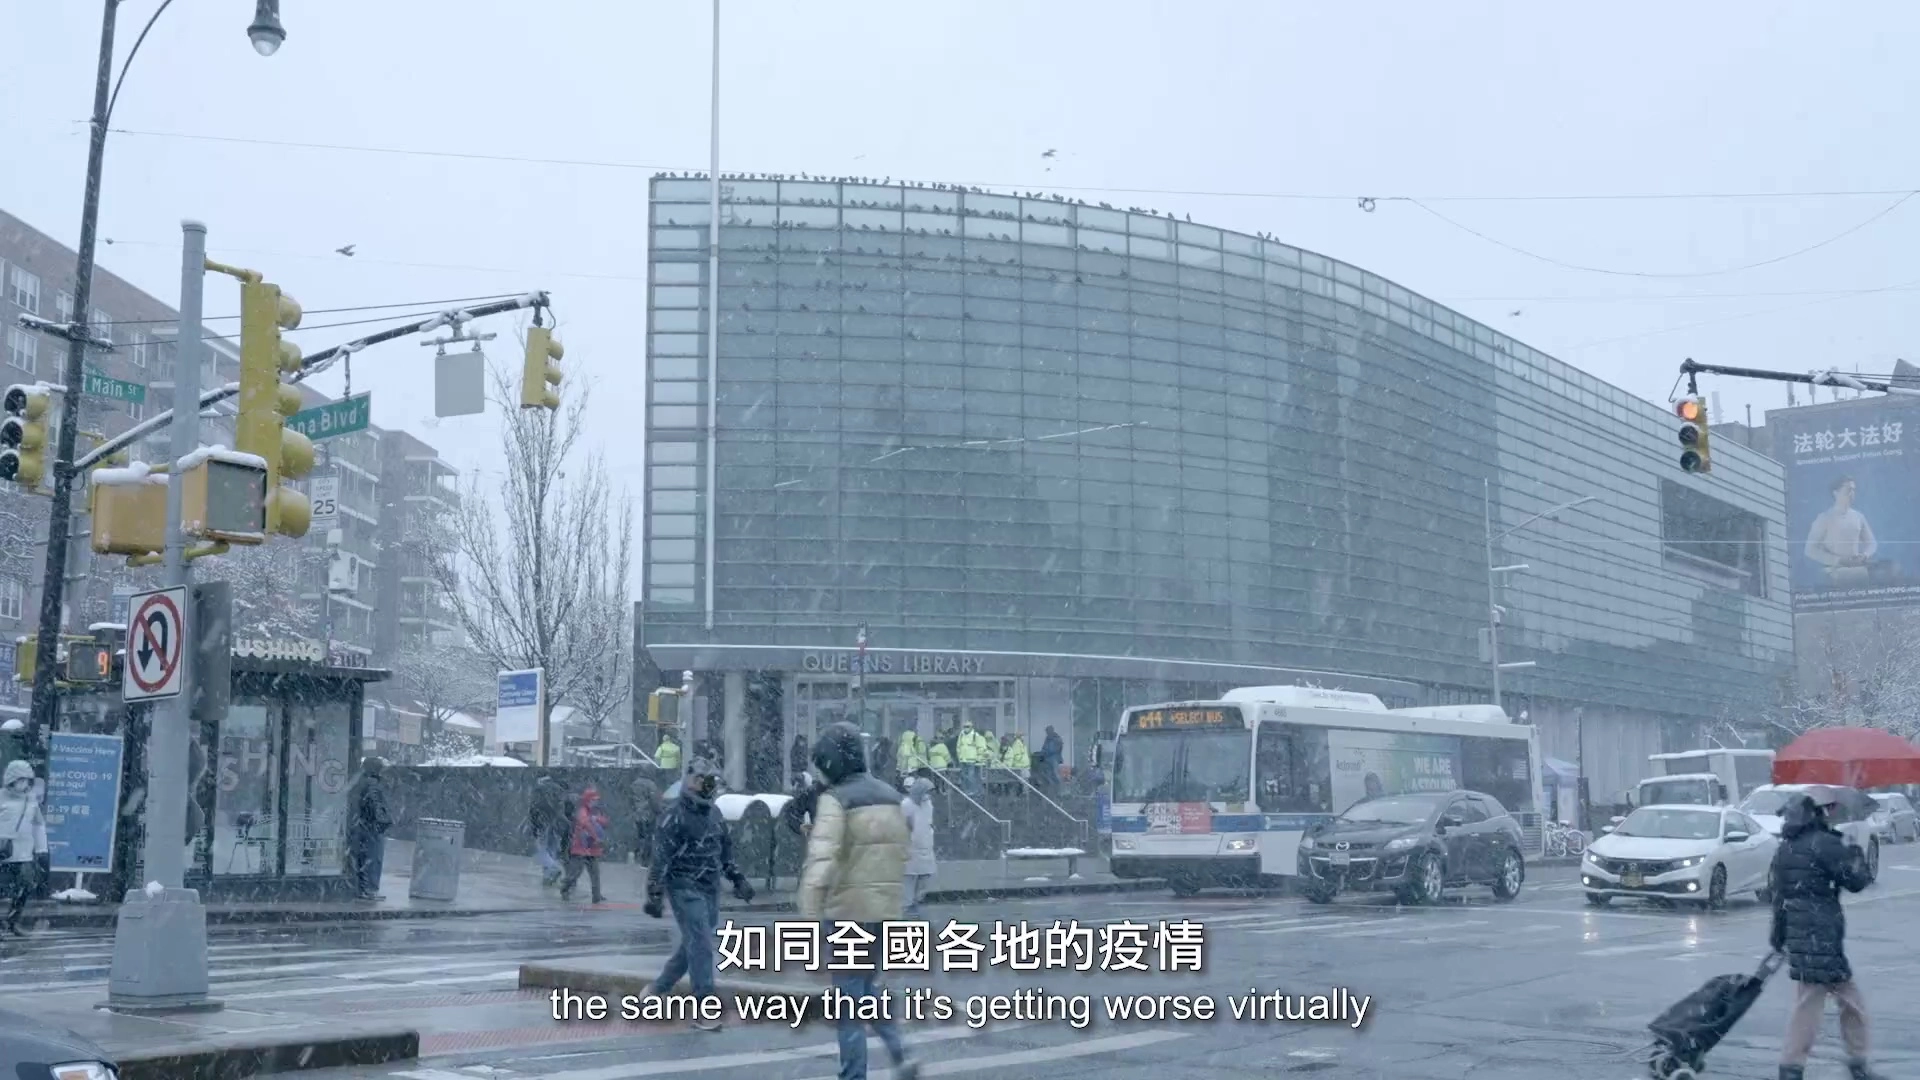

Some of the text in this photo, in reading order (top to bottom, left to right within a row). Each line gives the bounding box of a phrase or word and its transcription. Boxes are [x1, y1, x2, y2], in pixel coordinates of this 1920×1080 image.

[92, 378, 136, 397] Main St
[321, 407, 357, 431] Blvd
[1793, 421, 1903, 454] 法轮大法好
[313, 499, 335, 515] 25
[231, 637, 323, 662] USHING
[97, 651, 109, 676] 9
[802, 654, 985, 673] QUEENS LIBRARY
[1206, 711, 1224, 722] BUS
[1413, 756, 1452, 775] WE ARE
